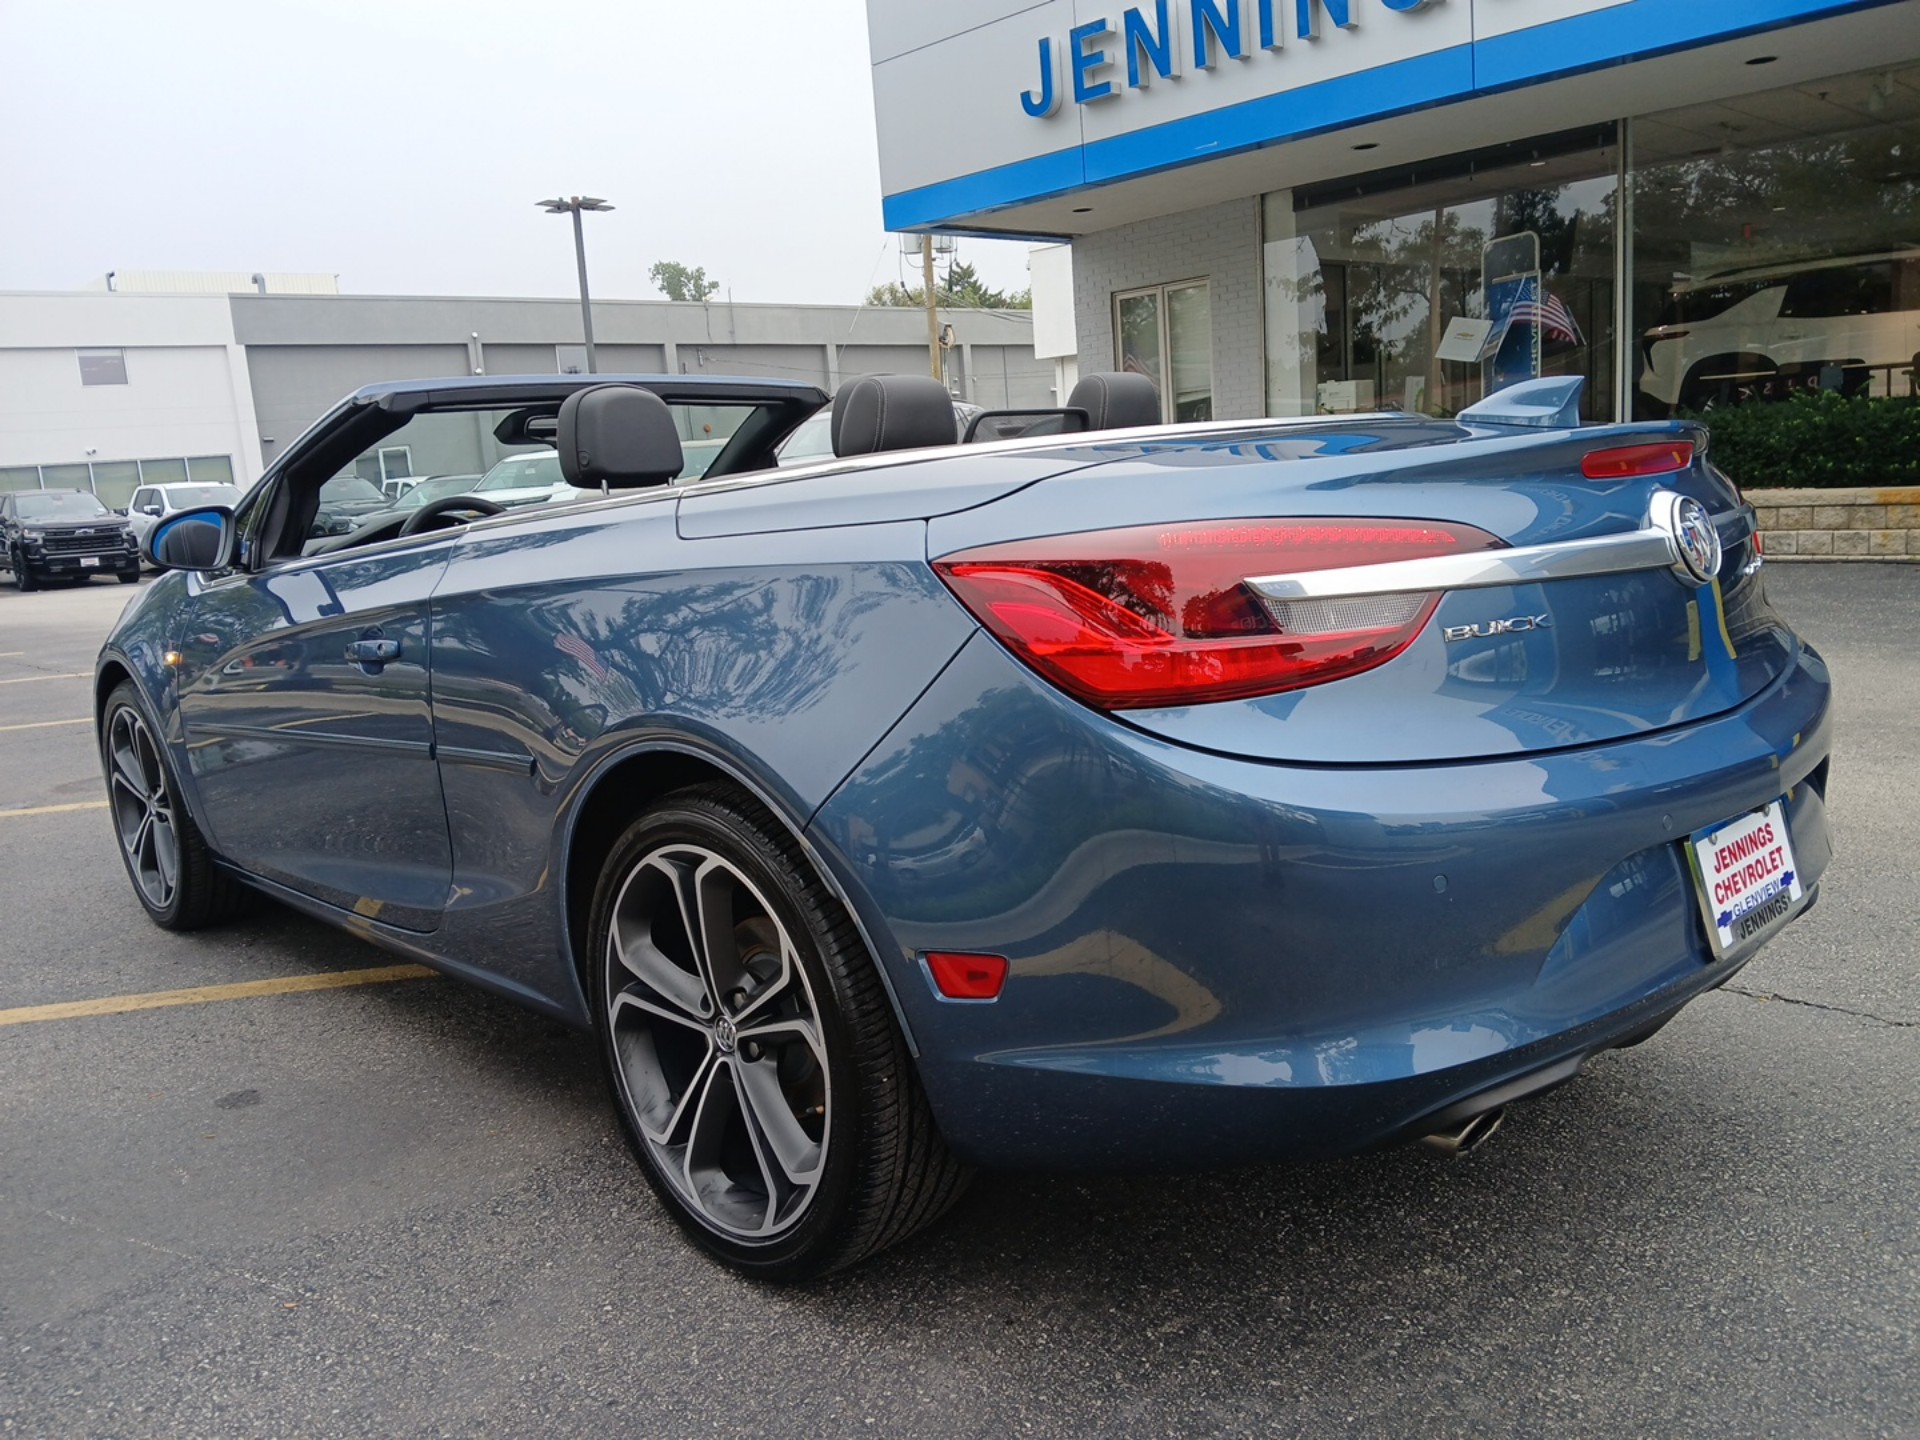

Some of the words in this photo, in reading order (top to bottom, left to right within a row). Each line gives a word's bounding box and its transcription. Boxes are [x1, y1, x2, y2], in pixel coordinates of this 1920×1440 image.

[1020, 0, 1424, 119] JENNI
[1443, 613, 1552, 642] BUICK
[1714, 822, 1774, 875] JENNINGS
[1714, 845, 1784, 905] CHEVROLET
[1733, 877, 1781, 917] GLENVIEW
